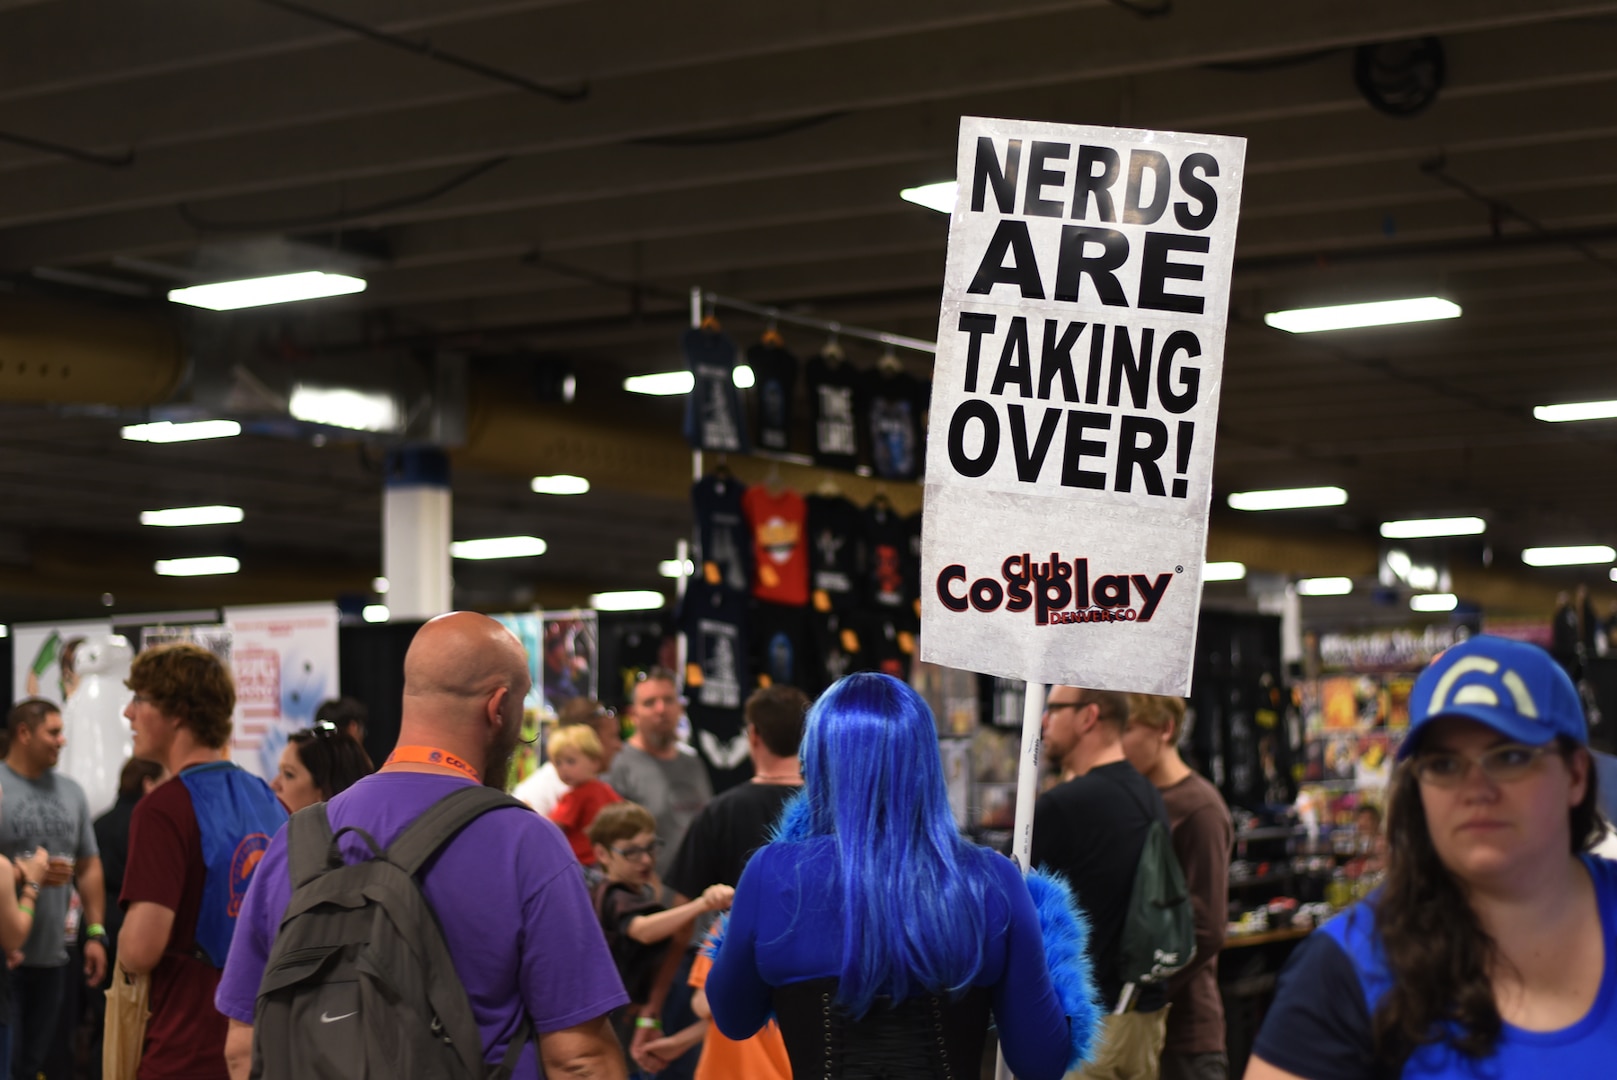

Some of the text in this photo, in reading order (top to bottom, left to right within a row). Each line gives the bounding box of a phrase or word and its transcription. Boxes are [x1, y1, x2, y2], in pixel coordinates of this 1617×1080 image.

[970, 136, 1220, 231] NERDS
[966, 219, 1211, 315] ARE
[957, 311, 1202, 415] TAKING
[947, 399, 1196, 499] OVER!
[936, 558, 1174, 626] Cosplay
